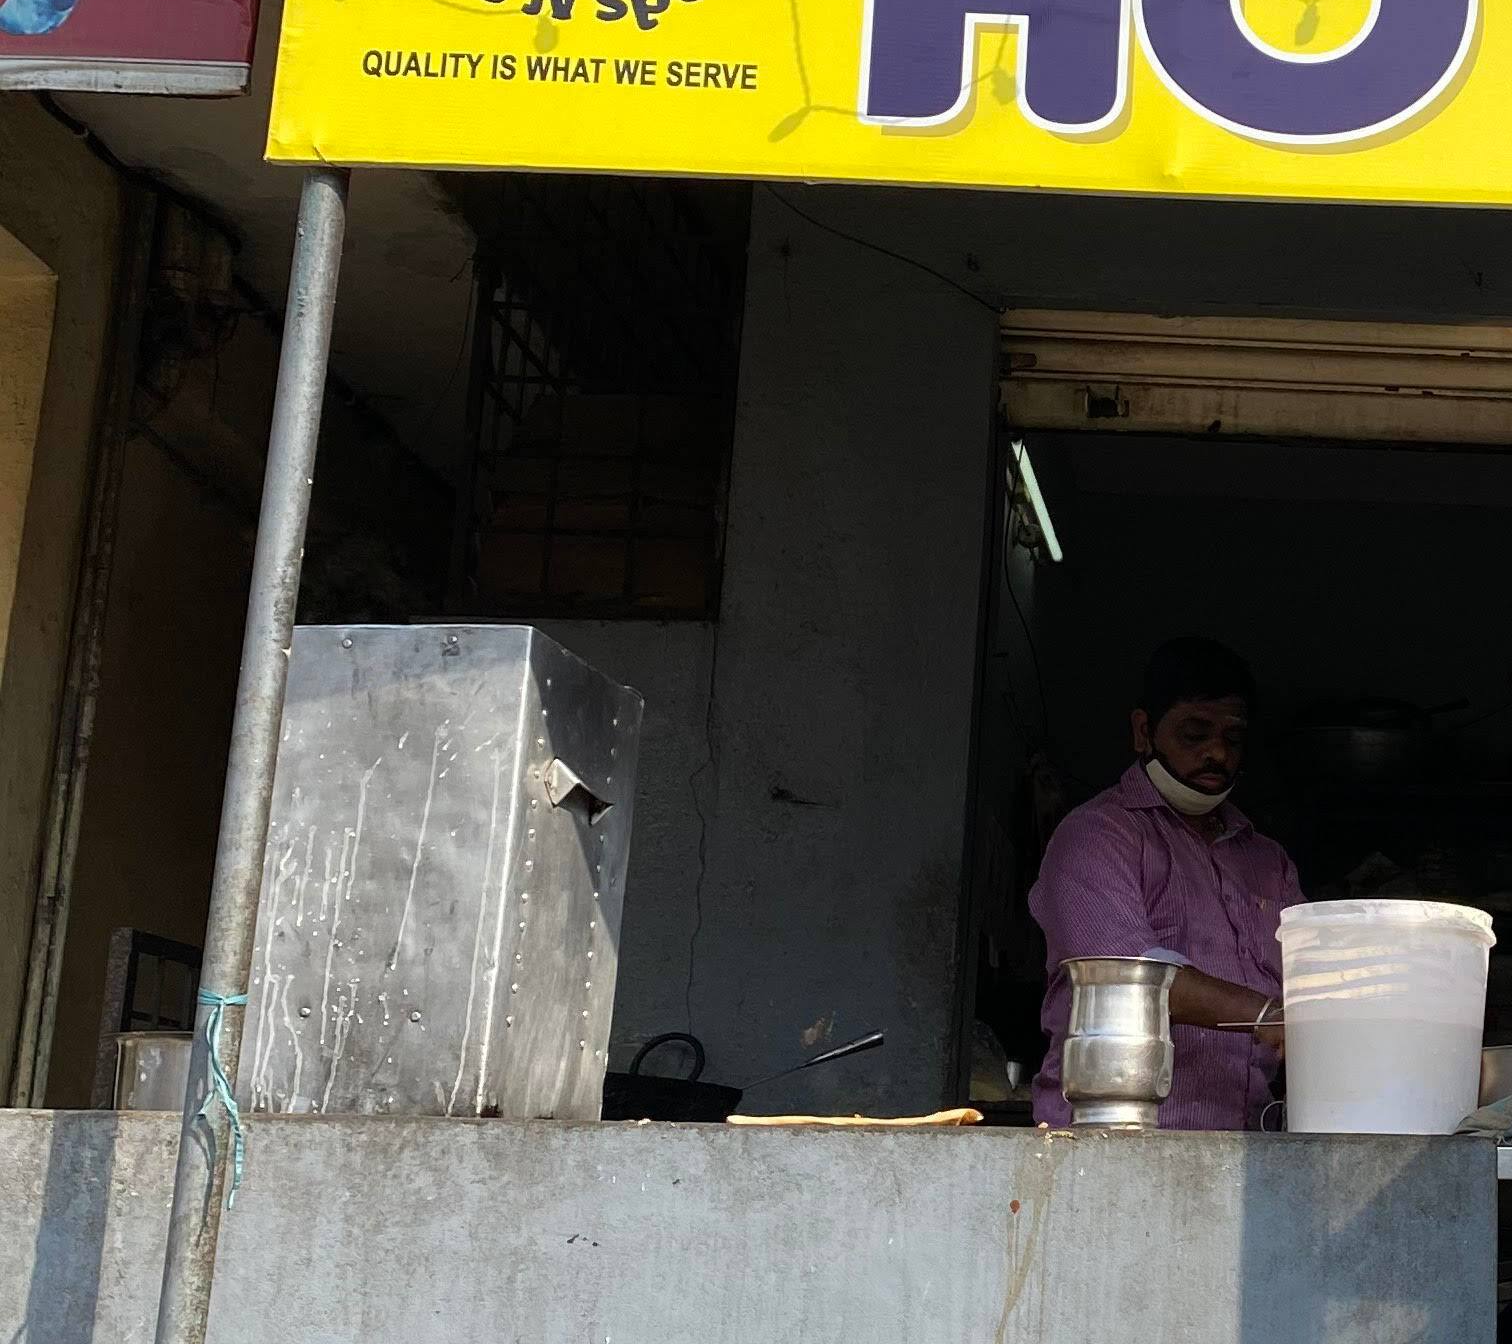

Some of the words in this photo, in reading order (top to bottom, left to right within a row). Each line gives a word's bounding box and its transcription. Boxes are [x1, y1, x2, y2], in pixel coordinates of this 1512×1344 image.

[361, 49, 485, 79] QUALITY
[491, 55, 517, 80] IS
[526, 56, 607, 85] WHAT
[614, 59, 656, 87] WE
[665, 61, 759, 90] SERVE
